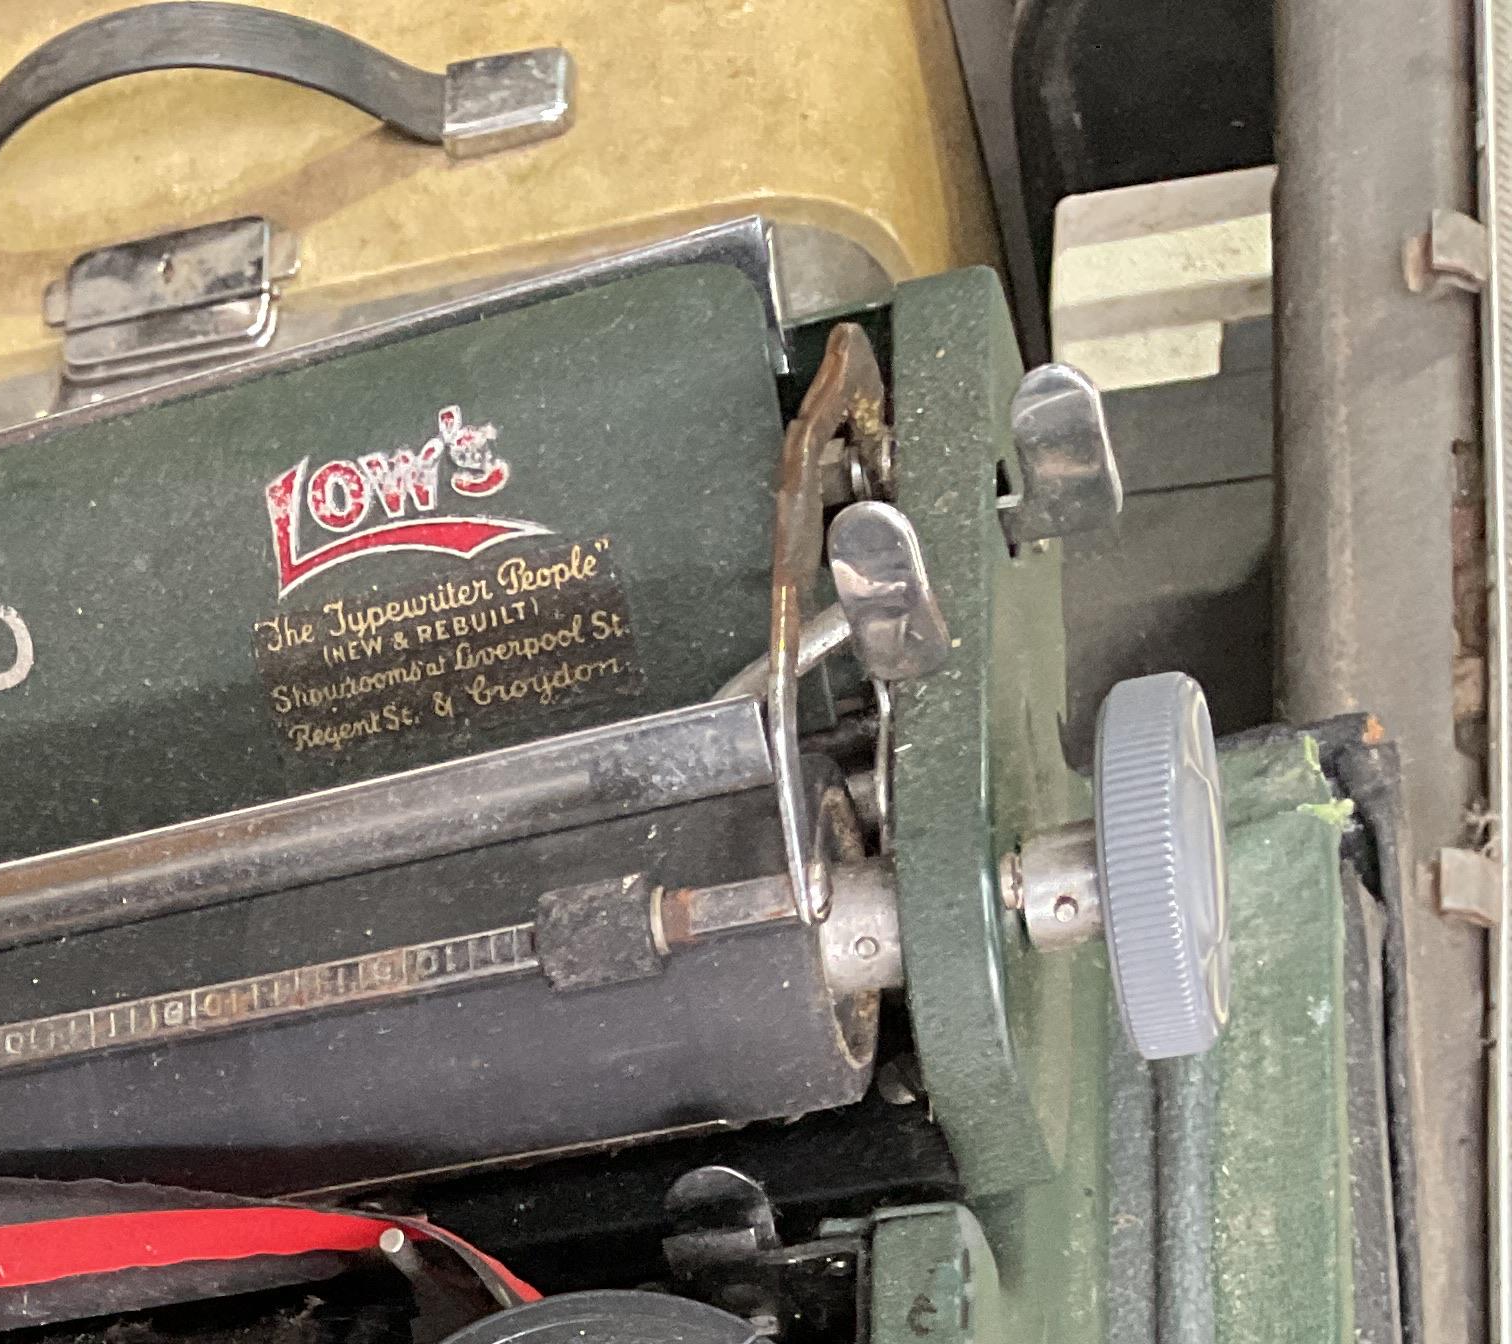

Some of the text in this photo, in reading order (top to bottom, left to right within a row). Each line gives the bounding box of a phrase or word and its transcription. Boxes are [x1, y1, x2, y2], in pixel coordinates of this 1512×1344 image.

[254, 616, 315, 651] The
[323, 579, 493, 638] Typewriter
[393, 631, 409, 650] &
[271, 661, 422, 713] Showrooms
[454, 614, 585, 671] Liverpool
[289, 712, 382, 751] Regent
[432, 691, 454, 717] &
